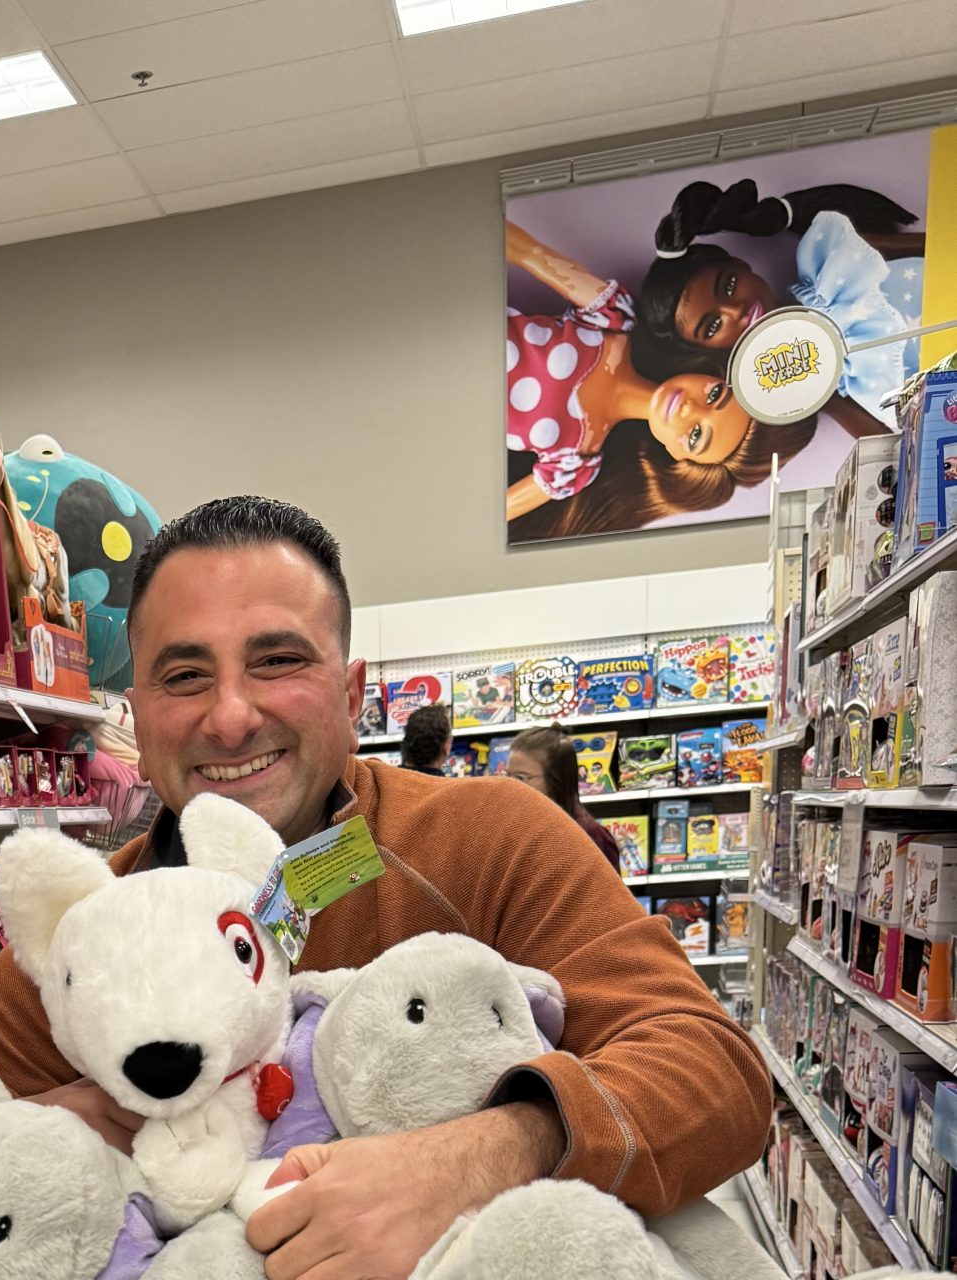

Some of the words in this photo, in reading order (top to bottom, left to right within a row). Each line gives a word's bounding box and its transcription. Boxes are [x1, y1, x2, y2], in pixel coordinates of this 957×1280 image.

[760, 342, 810, 376] MINI
[769, 360, 811, 384] VERSE
[583, 660, 649, 676] PERFECTION
[252, 884, 274, 914] GOODNESS
[269, 875, 278, 886] TO
